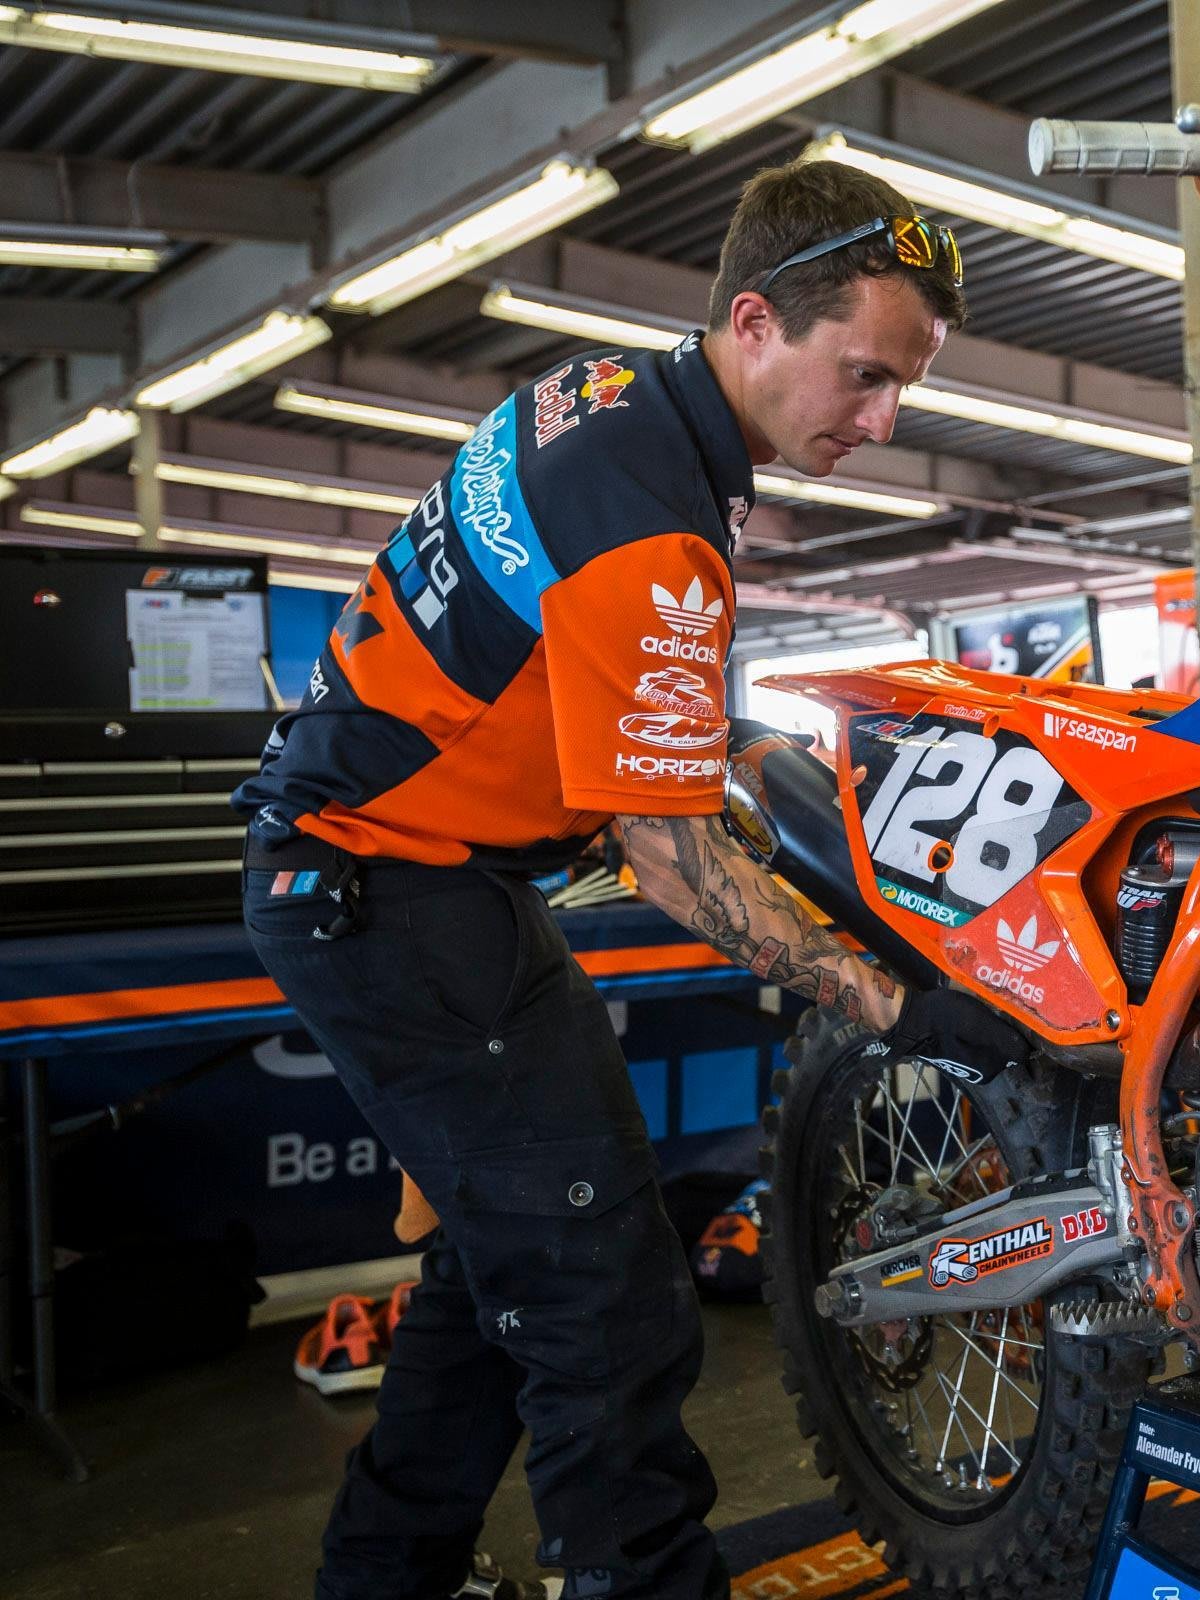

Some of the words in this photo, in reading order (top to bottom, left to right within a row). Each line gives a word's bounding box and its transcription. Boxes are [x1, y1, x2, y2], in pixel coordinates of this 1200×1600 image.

[534, 364, 577, 415] Red
[535, 397, 581, 449] Bull
[640, 635, 717, 664] adidas
[944, 704, 967, 716] Twin
[968, 708, 986, 720] Air
[1066, 719, 1136, 752] seaspan
[616, 753, 726, 776] HORIZON
[862, 727, 1064, 907] 128
[897, 889, 960, 927] MOTOREX
[977, 962, 1044, 1004] adidas
[267, 1132, 336, 1189] Be
[345, 1134, 378, 1177] a
[930, 1219, 1050, 1287] RENTHAL
[979, 1243, 1050, 1274] CHAINWHEELS
[1139, 1422, 1155, 1437] Rider:
[1136, 1435, 1184, 1466] Alexander
